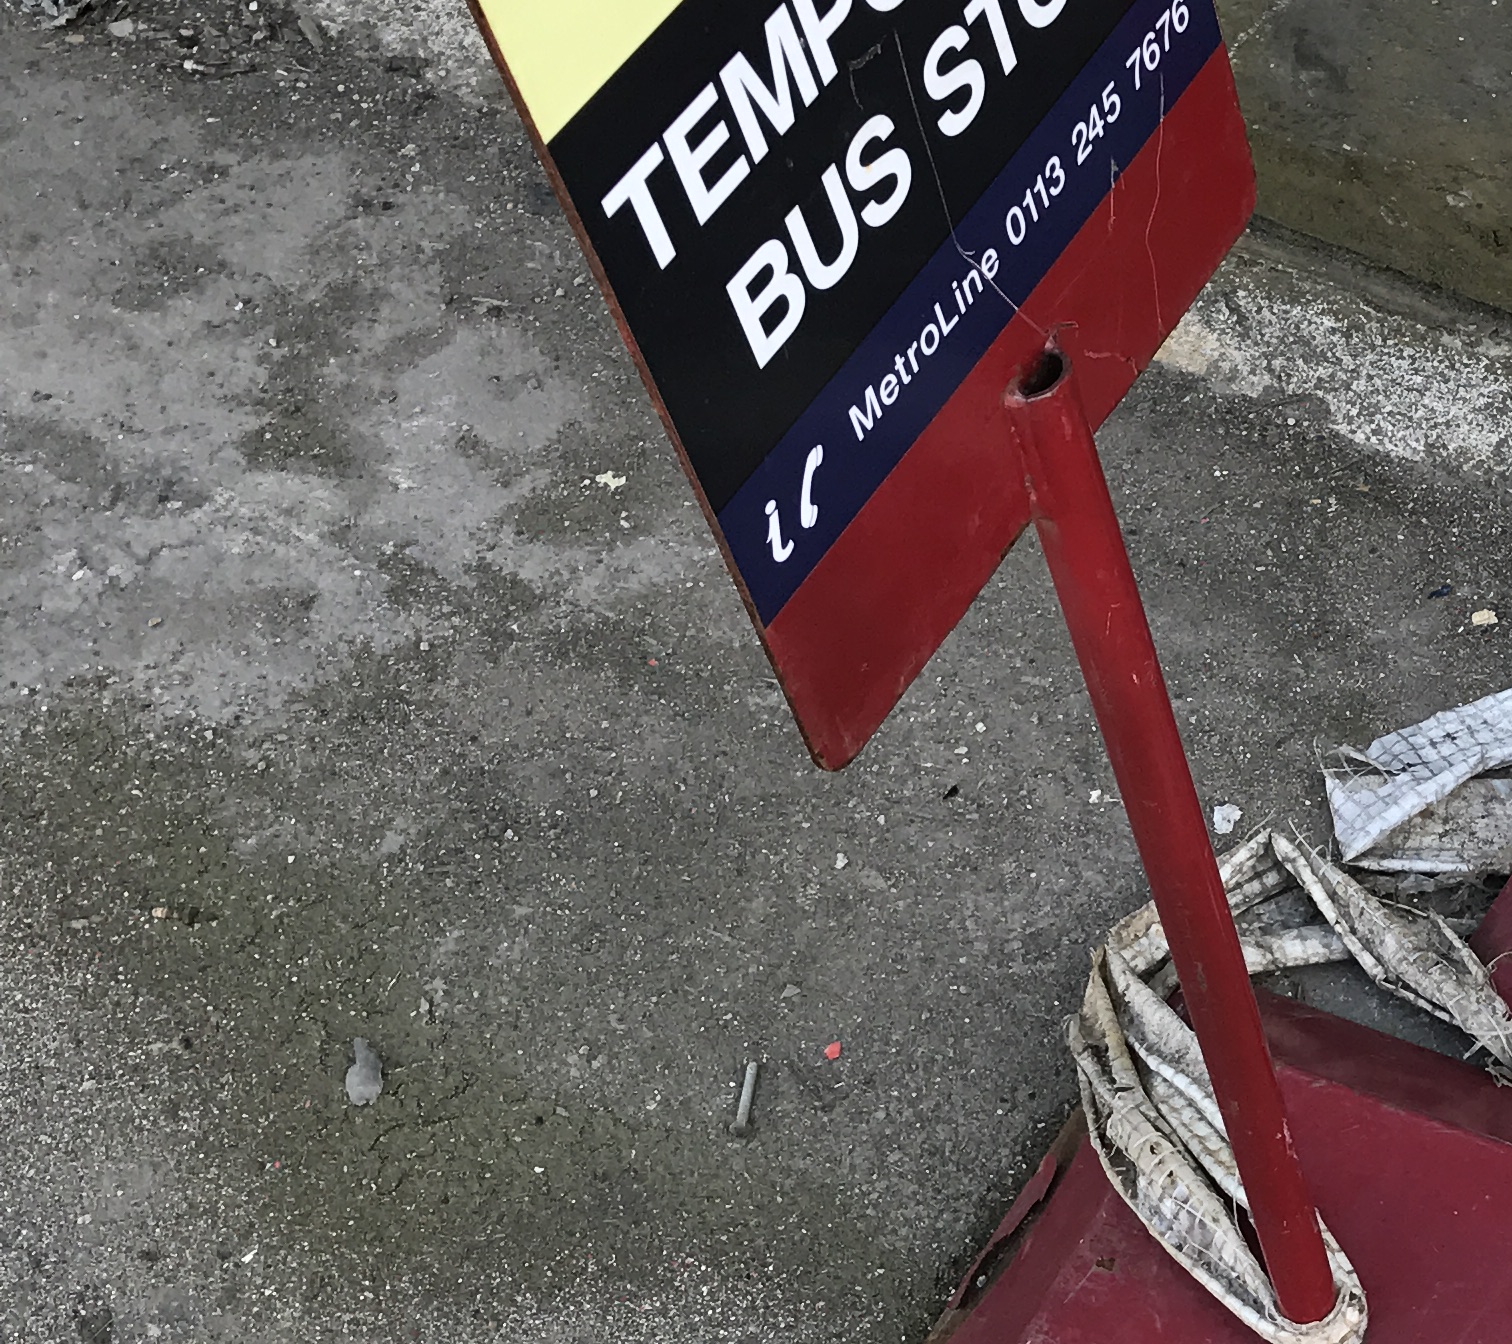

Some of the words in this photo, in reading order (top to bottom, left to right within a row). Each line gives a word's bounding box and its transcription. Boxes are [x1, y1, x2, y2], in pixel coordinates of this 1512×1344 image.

[725, 113, 913, 370] BUS
[846, 247, 1001, 443] MetroLine
[1005, 160, 1068, 247] 0113
[1070, 81, 1123, 166] 245
